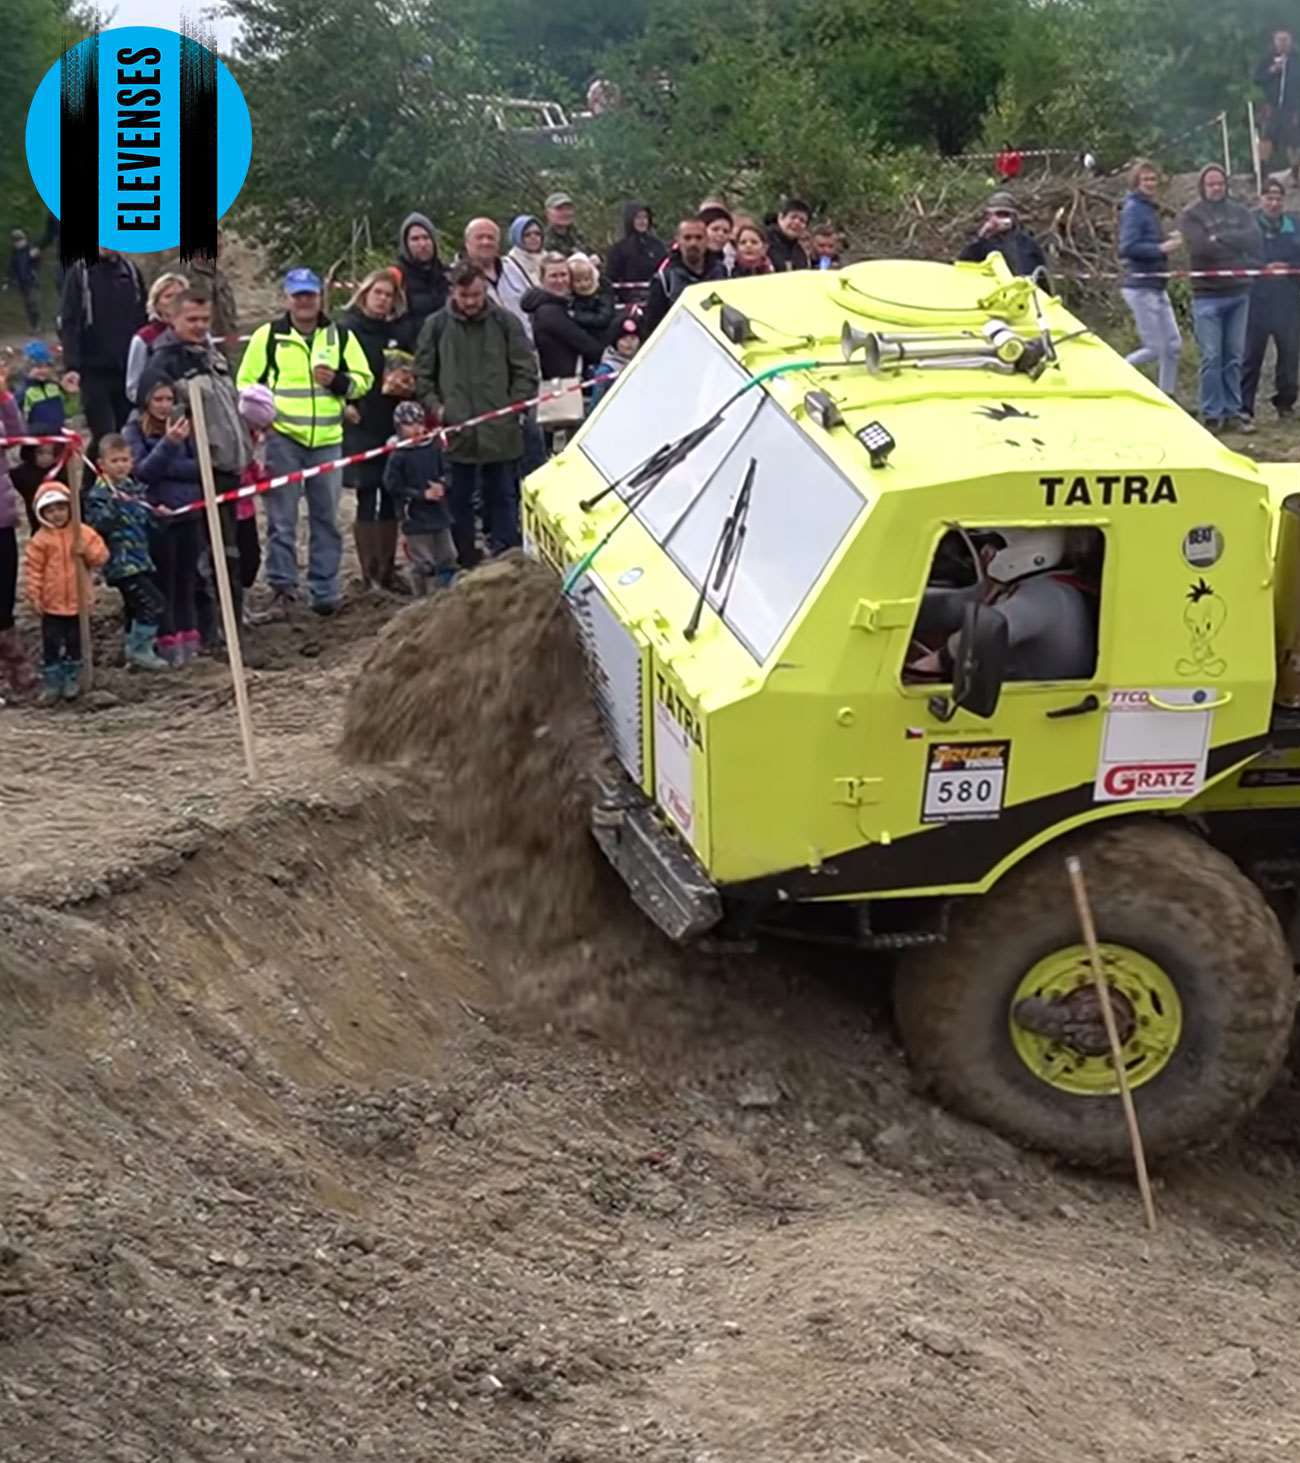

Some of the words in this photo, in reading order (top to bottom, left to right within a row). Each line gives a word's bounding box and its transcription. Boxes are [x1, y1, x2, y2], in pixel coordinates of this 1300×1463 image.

[1039, 475, 1177, 506] TATRA
[656, 671, 704, 753] TATRA
[938, 779, 992, 803] 580
[1103, 763, 1197, 796] GRATZ
